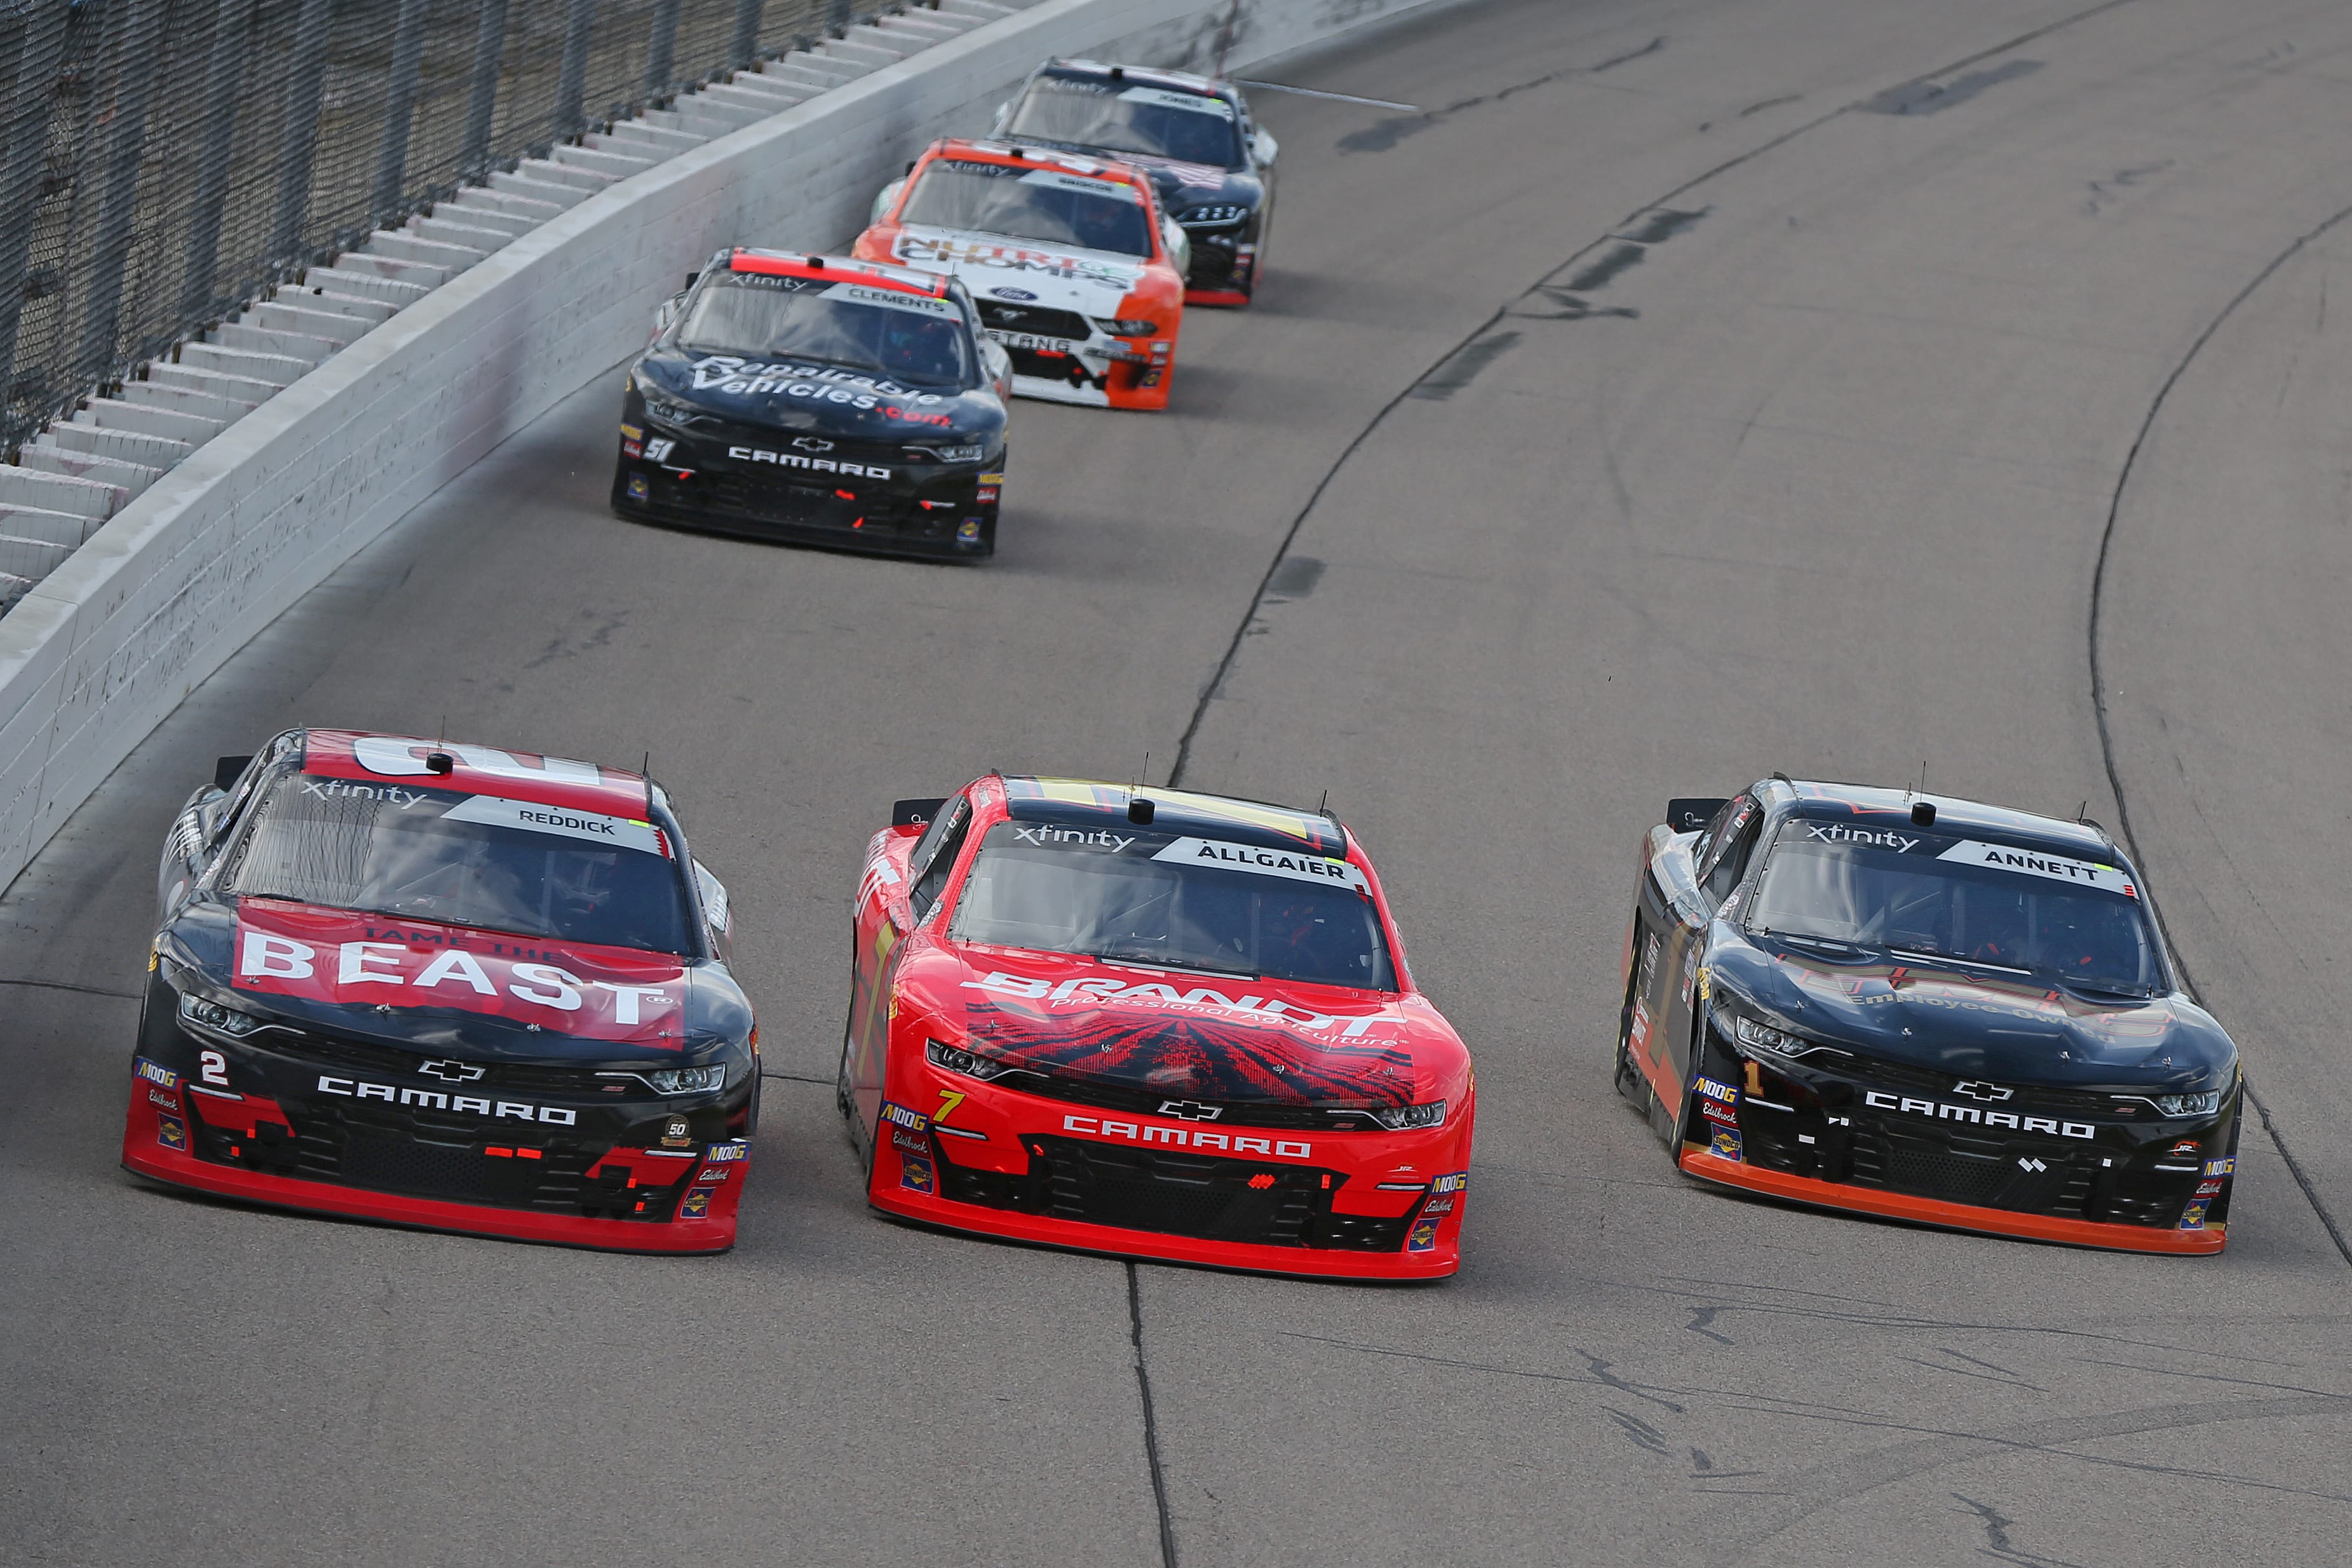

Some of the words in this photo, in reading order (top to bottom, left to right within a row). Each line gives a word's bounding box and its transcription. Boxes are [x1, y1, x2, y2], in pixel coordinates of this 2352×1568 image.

[943, 159, 1011, 177] xfinity
[1058, 177, 1113, 191] BRISCOE
[729, 273, 808, 291] xfinity
[848, 288, 945, 311] CLEMENTS
[691, 355, 943, 405] Repairable
[642, 436, 677, 463] 51
[728, 446, 891, 480] CAMARO
[301, 780, 428, 810] xfinity
[518, 810, 615, 835] REDDICK
[1013, 824, 1136, 853] xfinity
[1806, 824, 1920, 853] xfinity
[1197, 845, 1346, 880] ALLGAIER
[1984, 851, 2099, 881] ANNETT
[365, 927, 469, 948] TAME
[487, 942, 564, 964] THE
[241, 931, 665, 1025] BEAST
[959, 971, 1409, 1037] BRANDT
[1850, 994, 1999, 1014] Employee
[1240, 1013, 1398, 1047] Agriculture
[138, 1062, 177, 1087] MOOG
[201, 1050, 229, 1086] 2
[1743, 1060, 1764, 1098] 1
[149, 1089, 178, 1111] Edelbrock
[317, 1076, 576, 1126] CAMARO
[1693, 1076, 1738, 1104] MOOG
[880, 1104, 927, 1131] MOOG
[933, 1089, 966, 1123] 7
[1703, 1102, 1737, 1124] Edelbrock
[1865, 1090, 2095, 1139] CAMARO
[668, 1123, 686, 1135] 50
[893, 1131, 928, 1153] Edelbrock
[1063, 1114, 1311, 1158] CAMARO
[1715, 1136, 1740, 1149] SUNOCO
[708, 1145, 747, 1161] MOOG
[905, 1166, 931, 1181] SUNOCO
[2205, 1158, 2234, 1176] MOOG
[1432, 1173, 1466, 1193] MOOG
